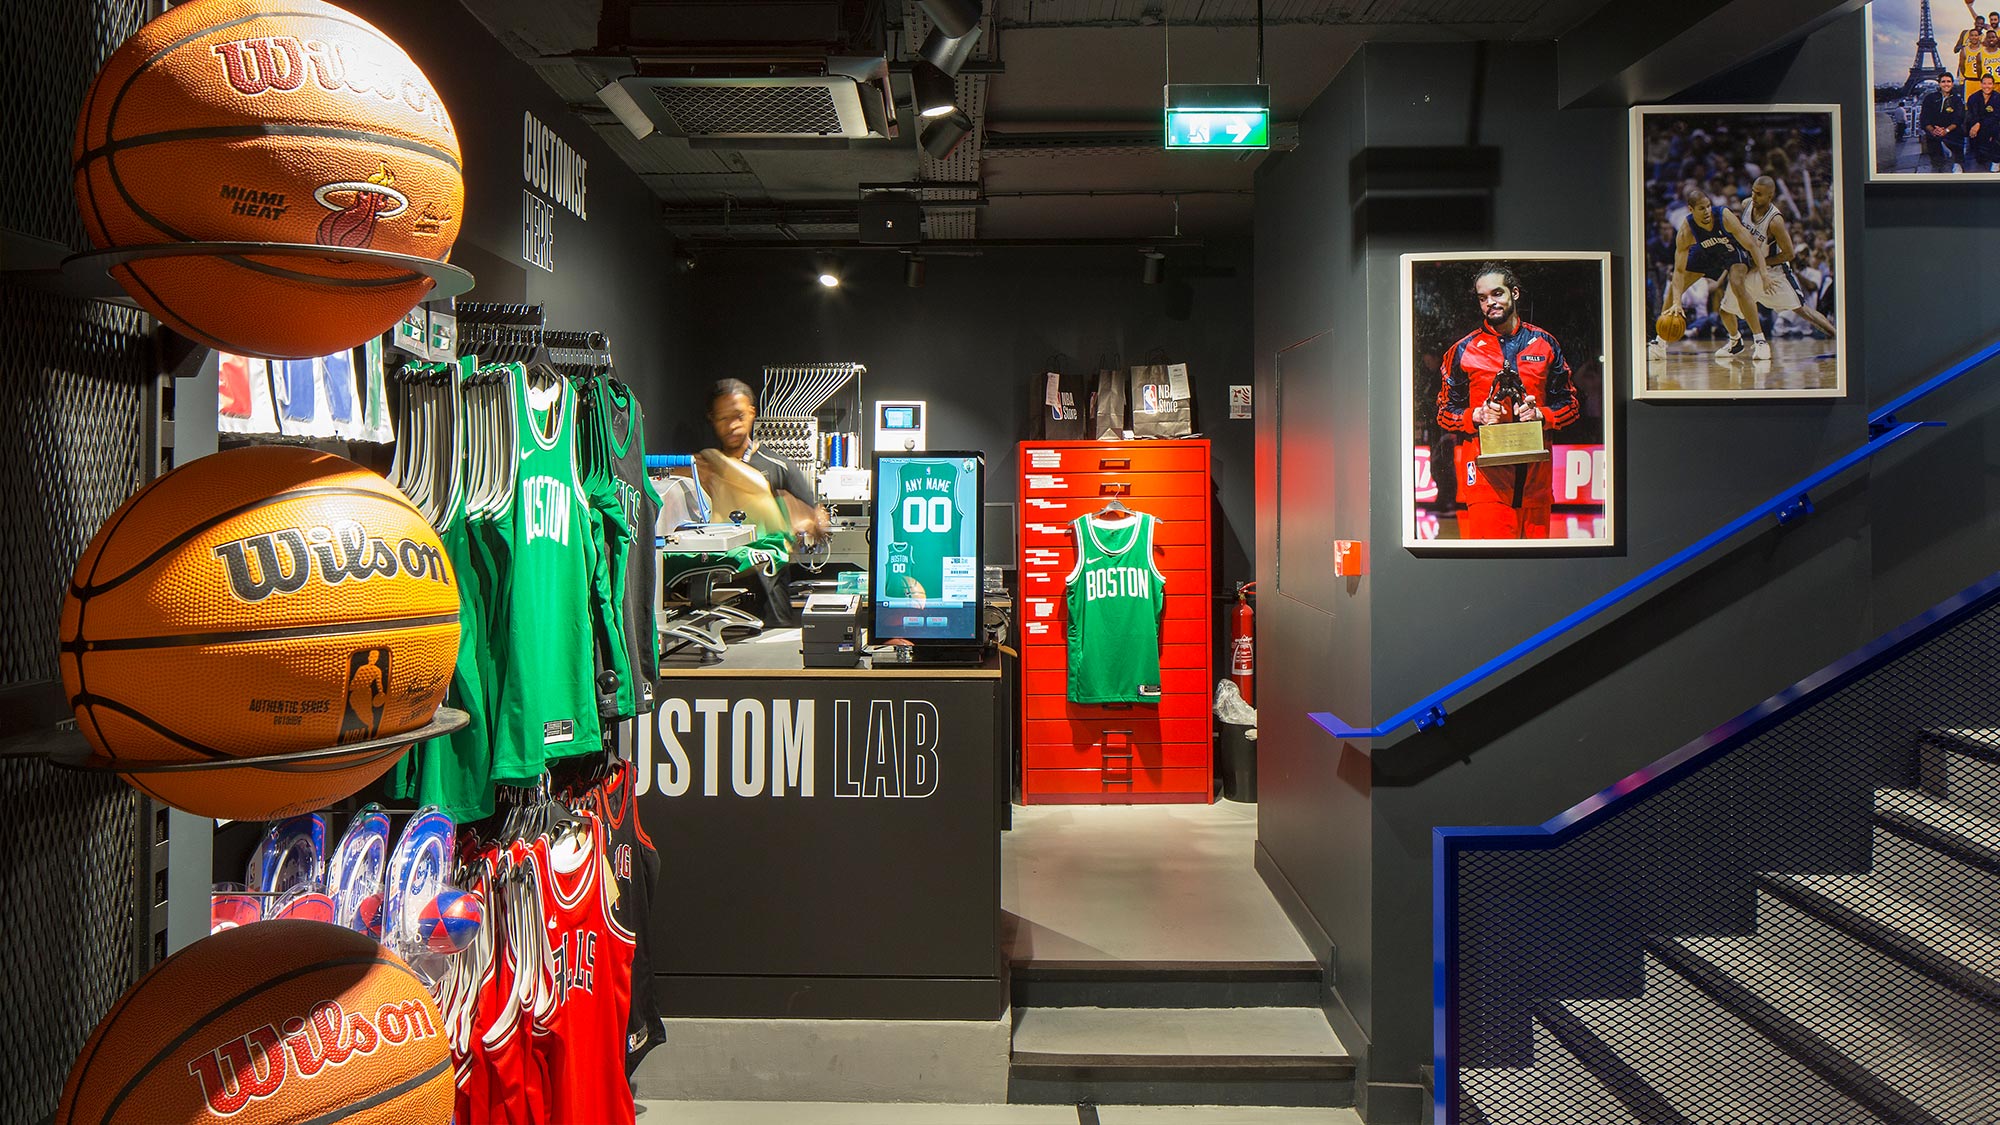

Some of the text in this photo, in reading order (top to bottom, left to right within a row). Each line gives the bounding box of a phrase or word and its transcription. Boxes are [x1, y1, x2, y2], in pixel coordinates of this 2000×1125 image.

[212, 35, 451, 134] Wion
[523, 110, 588, 222] CUSTOMISE
[221, 184, 285, 206] MIAMI
[231, 201, 291, 220] HEAT
[522, 188, 554, 273] HERE
[1742, 222, 1767, 243] PURS
[1061, 392, 1074, 407] NBA
[1158, 384, 1172, 399] NB
[1063, 406, 1078, 421] Store
[1159, 398, 1178, 414] Store
[905, 477, 951, 493] ANY NAME
[903, 496, 952, 533] 00
[213, 520, 450, 603] Wilson
[890, 554, 909, 563] BOSTON
[892, 563, 906, 573] 00
[1085, 567, 1149, 602] BOSTON
[249, 699, 331, 714] AUTHENTIC SERIES
[618, 698, 939, 798] USTOM LAB
[187, 1000, 437, 1117] Wilson
